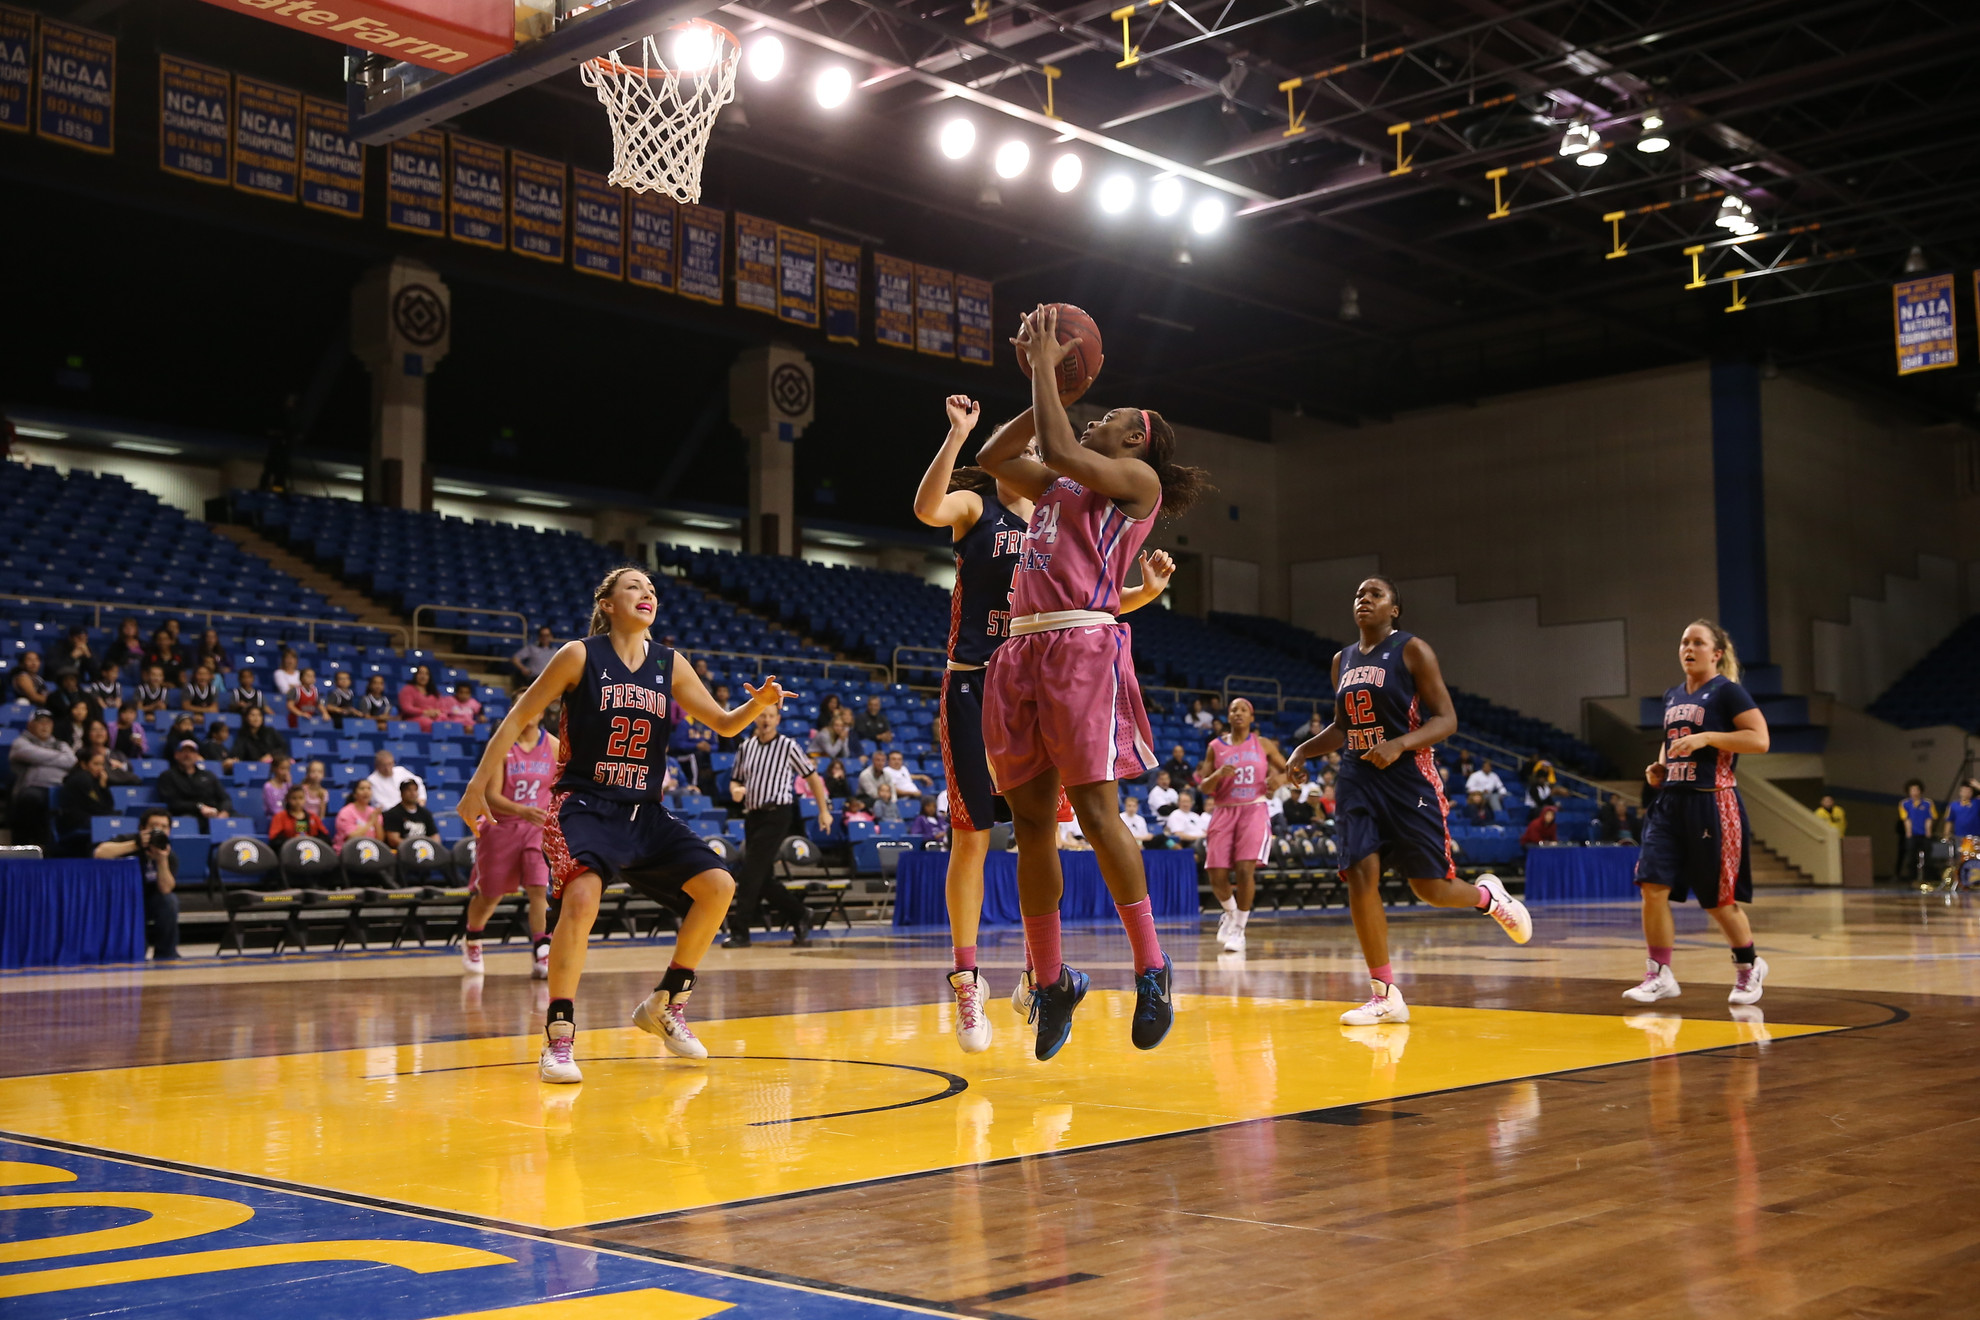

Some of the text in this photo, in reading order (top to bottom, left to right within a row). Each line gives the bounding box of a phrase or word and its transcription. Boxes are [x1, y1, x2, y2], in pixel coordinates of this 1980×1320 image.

[46, 53, 108, 89] NCAA
[42, 73, 112, 107] CHAMPIONS
[46, 94, 104, 126] BOXING
[166, 89, 226, 121] NCAA
[163, 111, 228, 140] CHAMPIONS
[240, 109, 293, 141] NCAA
[166, 130, 223, 158] BOXING
[238, 128, 296, 160] CHAMPIONS
[307, 128, 361, 159] NCAA
[305, 147, 363, 177] CHAMPIONS
[392, 152, 441, 179] NCAA
[390, 170, 442, 195] CHAMPIONS
[456, 165, 502, 193] NCAA
[453, 183, 504, 210] CHAMPIONS
[516, 179, 561, 207] NCAA
[514, 196, 564, 222] CHAMPIONS
[576, 201, 620, 228] NCAA
[633, 210, 673, 236] NIVC
[687, 225, 718, 248] WAC
[740, 233, 775, 254] NCAA
[686, 255, 715, 273] WEST
[781, 254, 816, 274] COLLEGE
[784, 268, 812, 285] WORLD
[824, 259, 858, 279] NCAA
[681, 277, 722, 300] CHAMPIONS
[783, 279, 813, 297] SERIES
[918, 284, 951, 303] NCAA
[958, 296, 990, 317] NCAA
[1900, 298, 1950, 321] NAIA
[1898, 325, 1953, 346] TOURNAMENT
[1902, 315, 1949, 333] NATIONAL
[1026, 501, 1062, 545] 34
[1336, 665, 1387, 695] FRESNO
[600, 683, 668, 720] FRESNO
[1344, 689, 1377, 726] 42
[606, 715, 653, 760] 22
[1347, 726, 1388, 751] STATE
[593, 761, 650, 791] STATE
[1233, 764, 1256, 786] 33
[513, 779, 542, 802] 24
